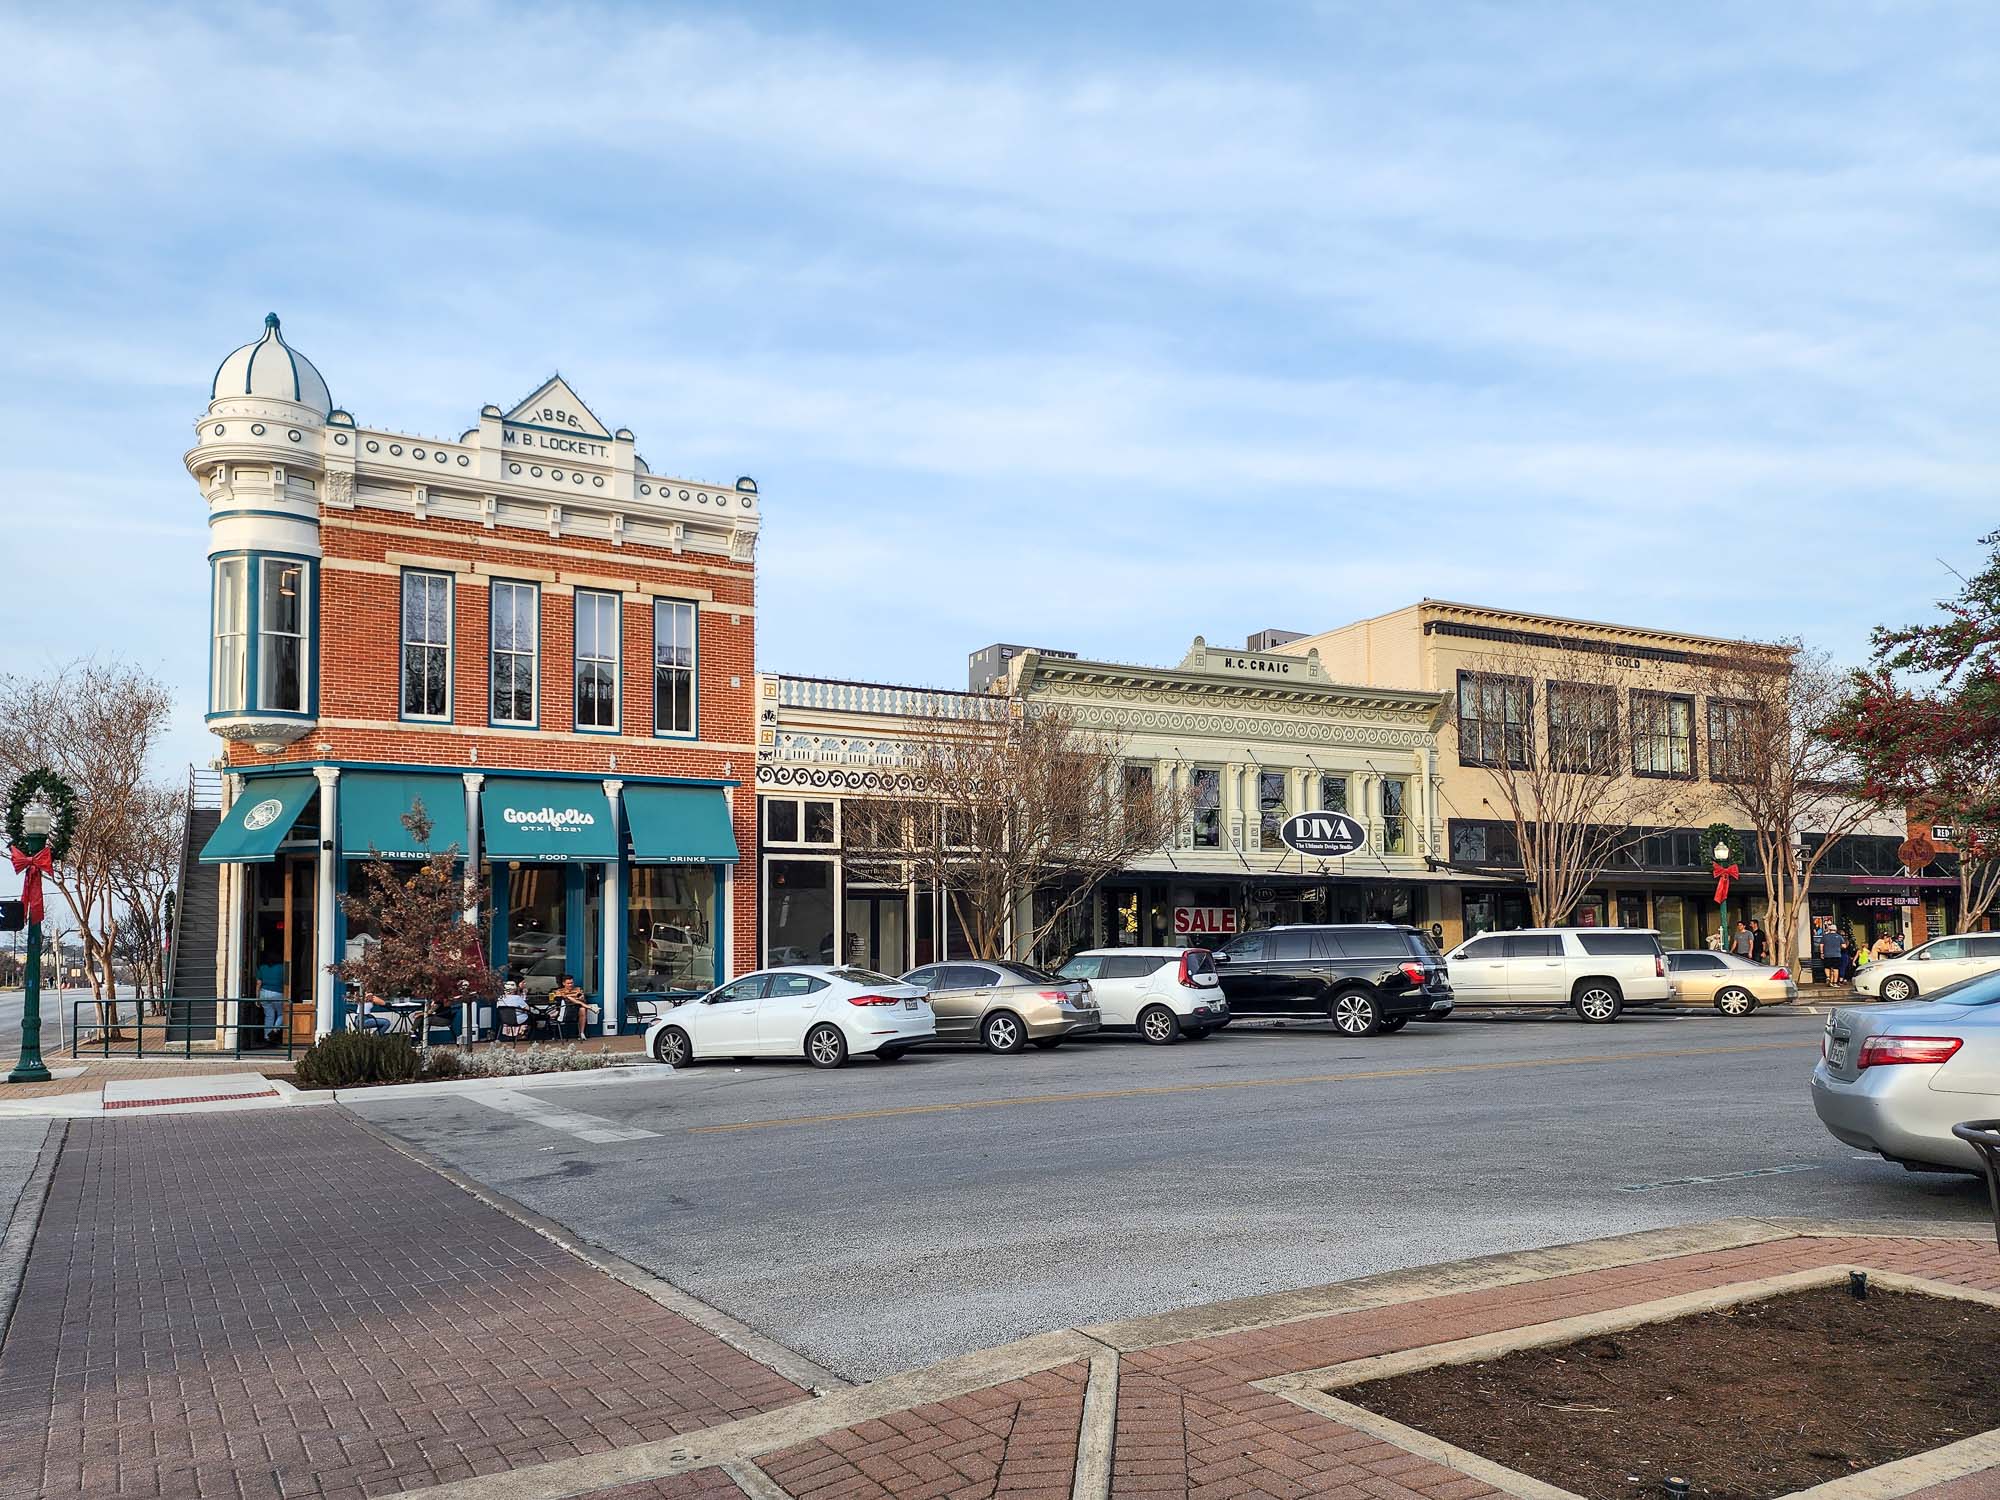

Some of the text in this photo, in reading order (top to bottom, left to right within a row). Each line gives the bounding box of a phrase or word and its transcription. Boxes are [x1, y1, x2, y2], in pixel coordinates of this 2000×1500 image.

[503, 807, 595, 827] Goodfolks
[1296, 818, 1352, 840] DIVA
[1296, 842, 1305, 850] The
[1305, 842, 1324, 850] Ultimate
[1325, 843, 1339, 851] Design
[380, 851, 431, 859] FRIENDS
[1857, 897, 1893, 906] COFFEE
[1175, 908, 1235, 932] SALE
